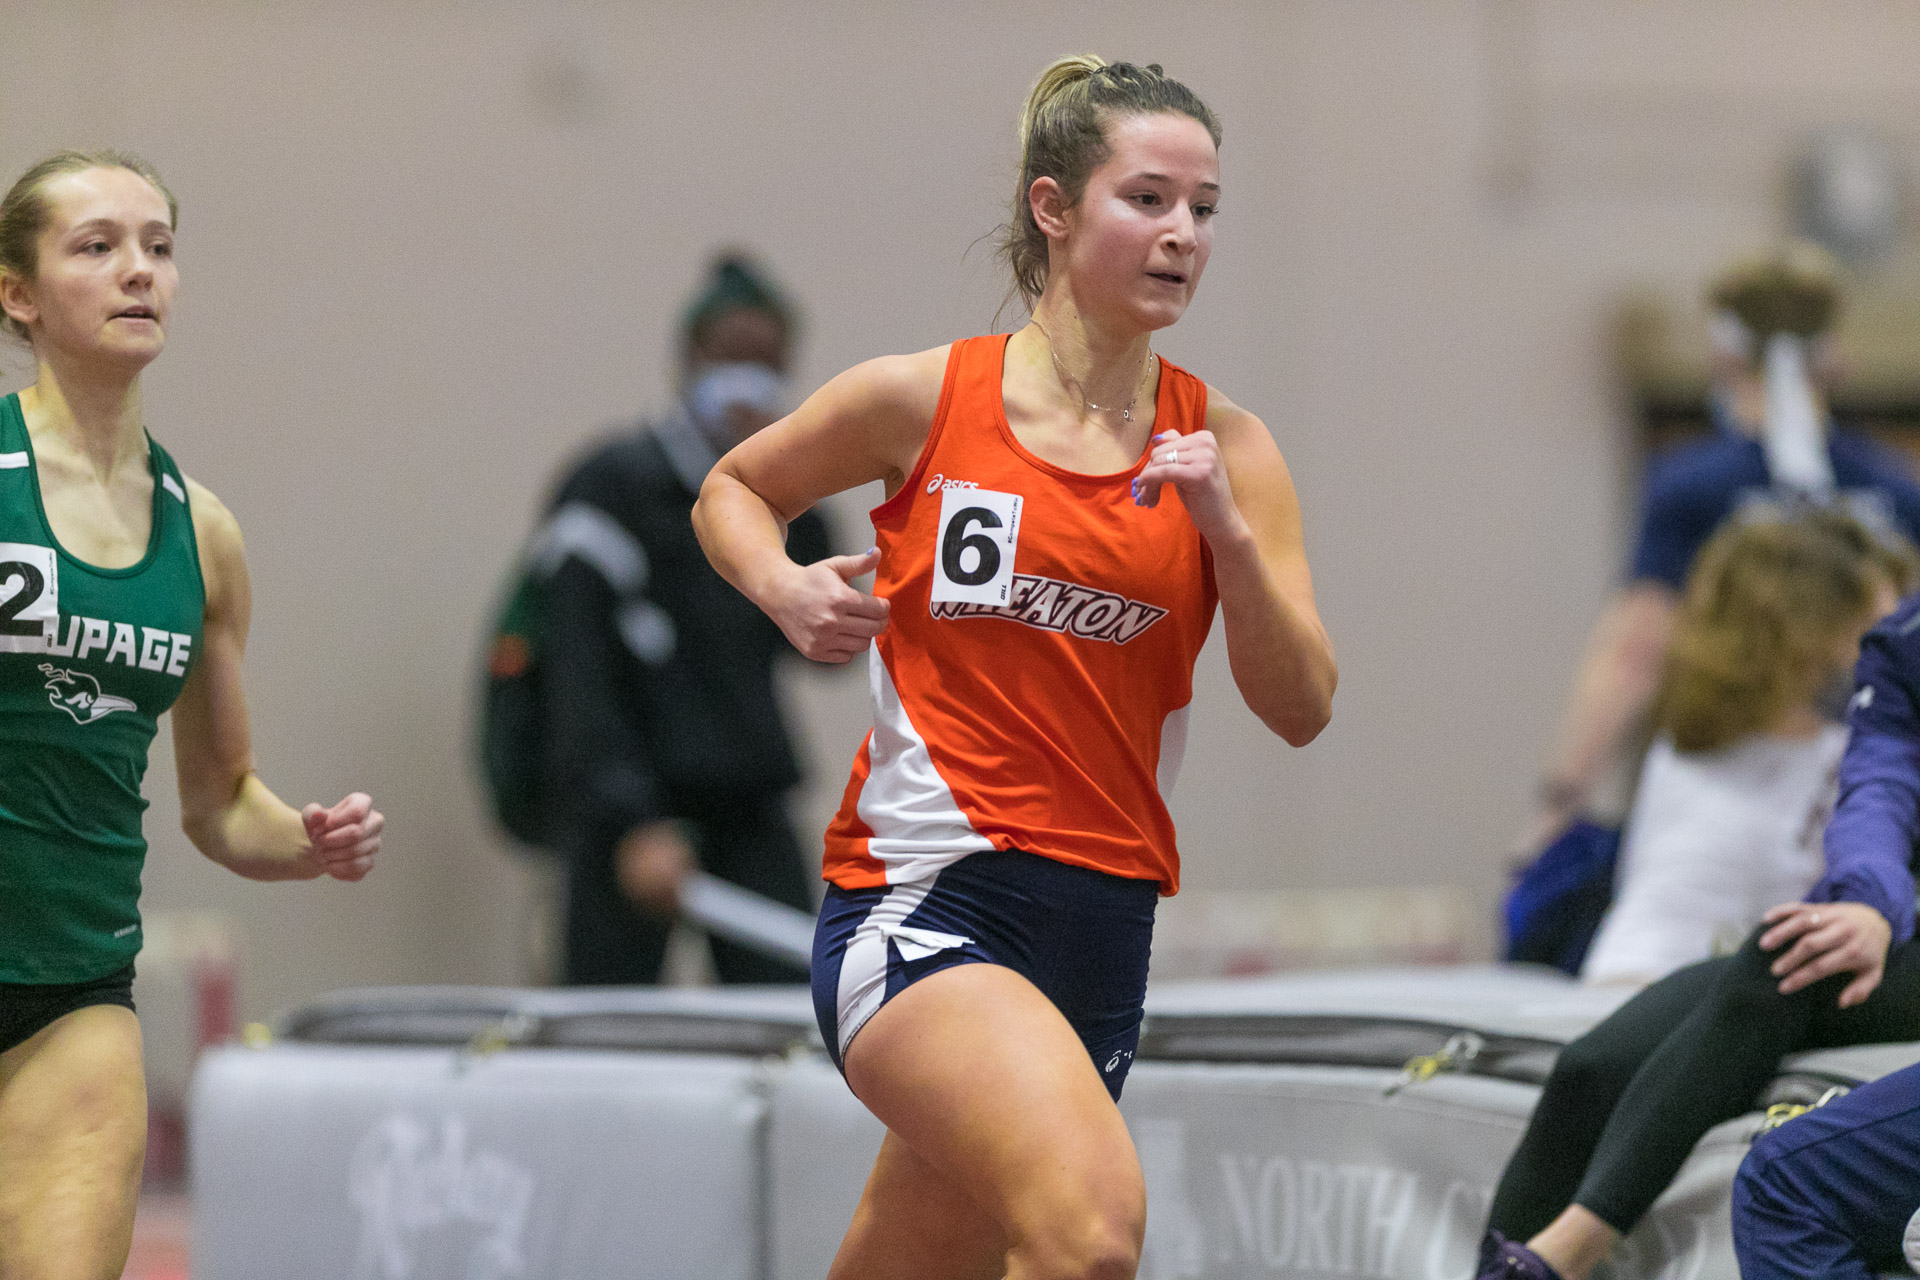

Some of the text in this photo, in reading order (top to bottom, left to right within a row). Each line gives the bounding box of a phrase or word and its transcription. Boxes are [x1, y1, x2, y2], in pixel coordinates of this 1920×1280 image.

[941, 506, 1003, 586] 6
[0, 561, 45, 637] 2
[930, 573, 1169, 644] EATON
[48, 615, 192, 676] UPAGE
[1217, 1152, 1420, 1277] NORTH
